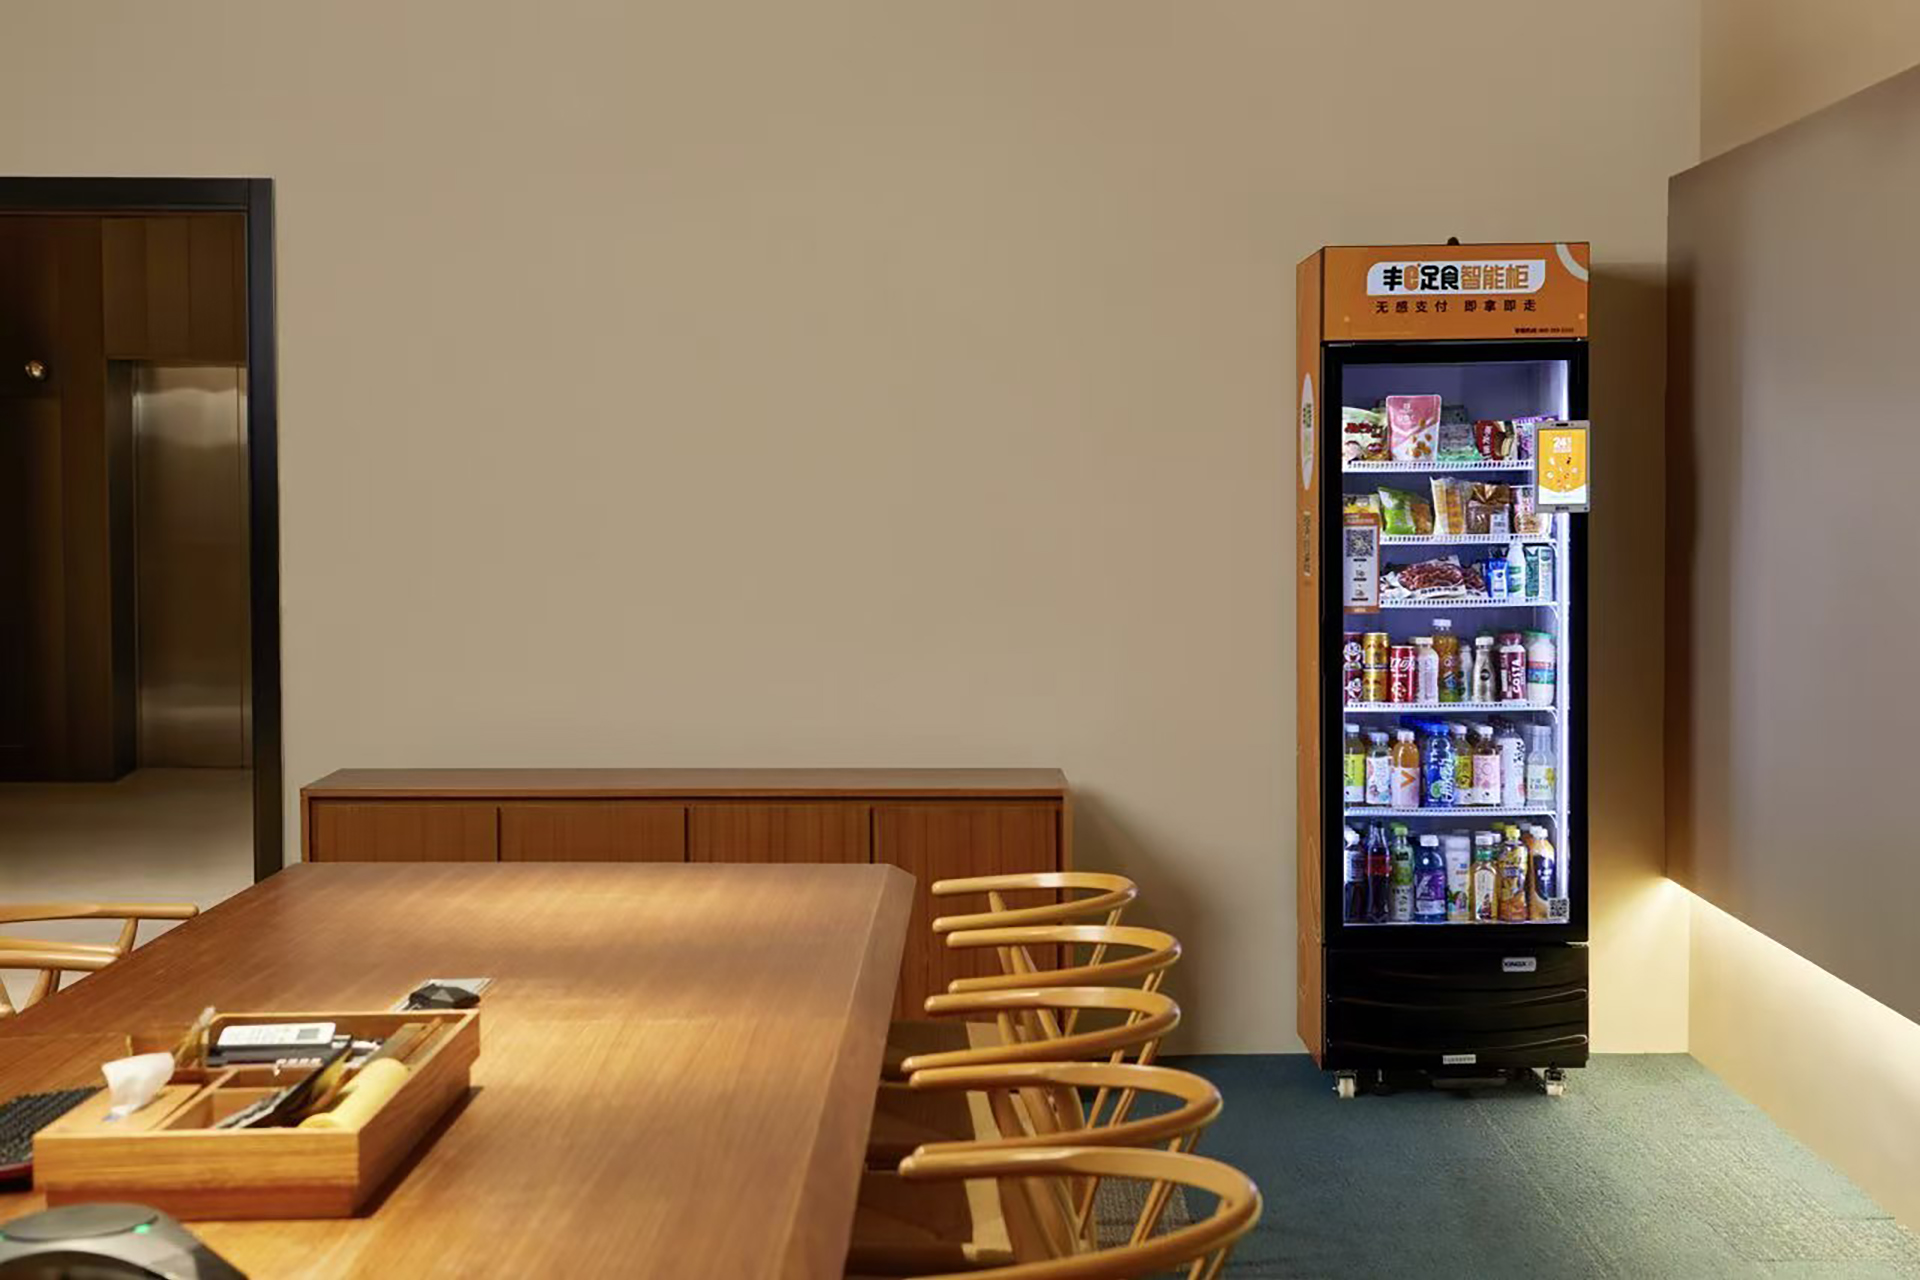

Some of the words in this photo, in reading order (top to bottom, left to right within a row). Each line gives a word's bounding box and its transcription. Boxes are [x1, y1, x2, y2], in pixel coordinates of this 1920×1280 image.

[1376, 301, 1448, 314] 无感支付
[1464, 300, 1537, 312] 即拿即走
[1511, 659, 1522, 693] COSTA
